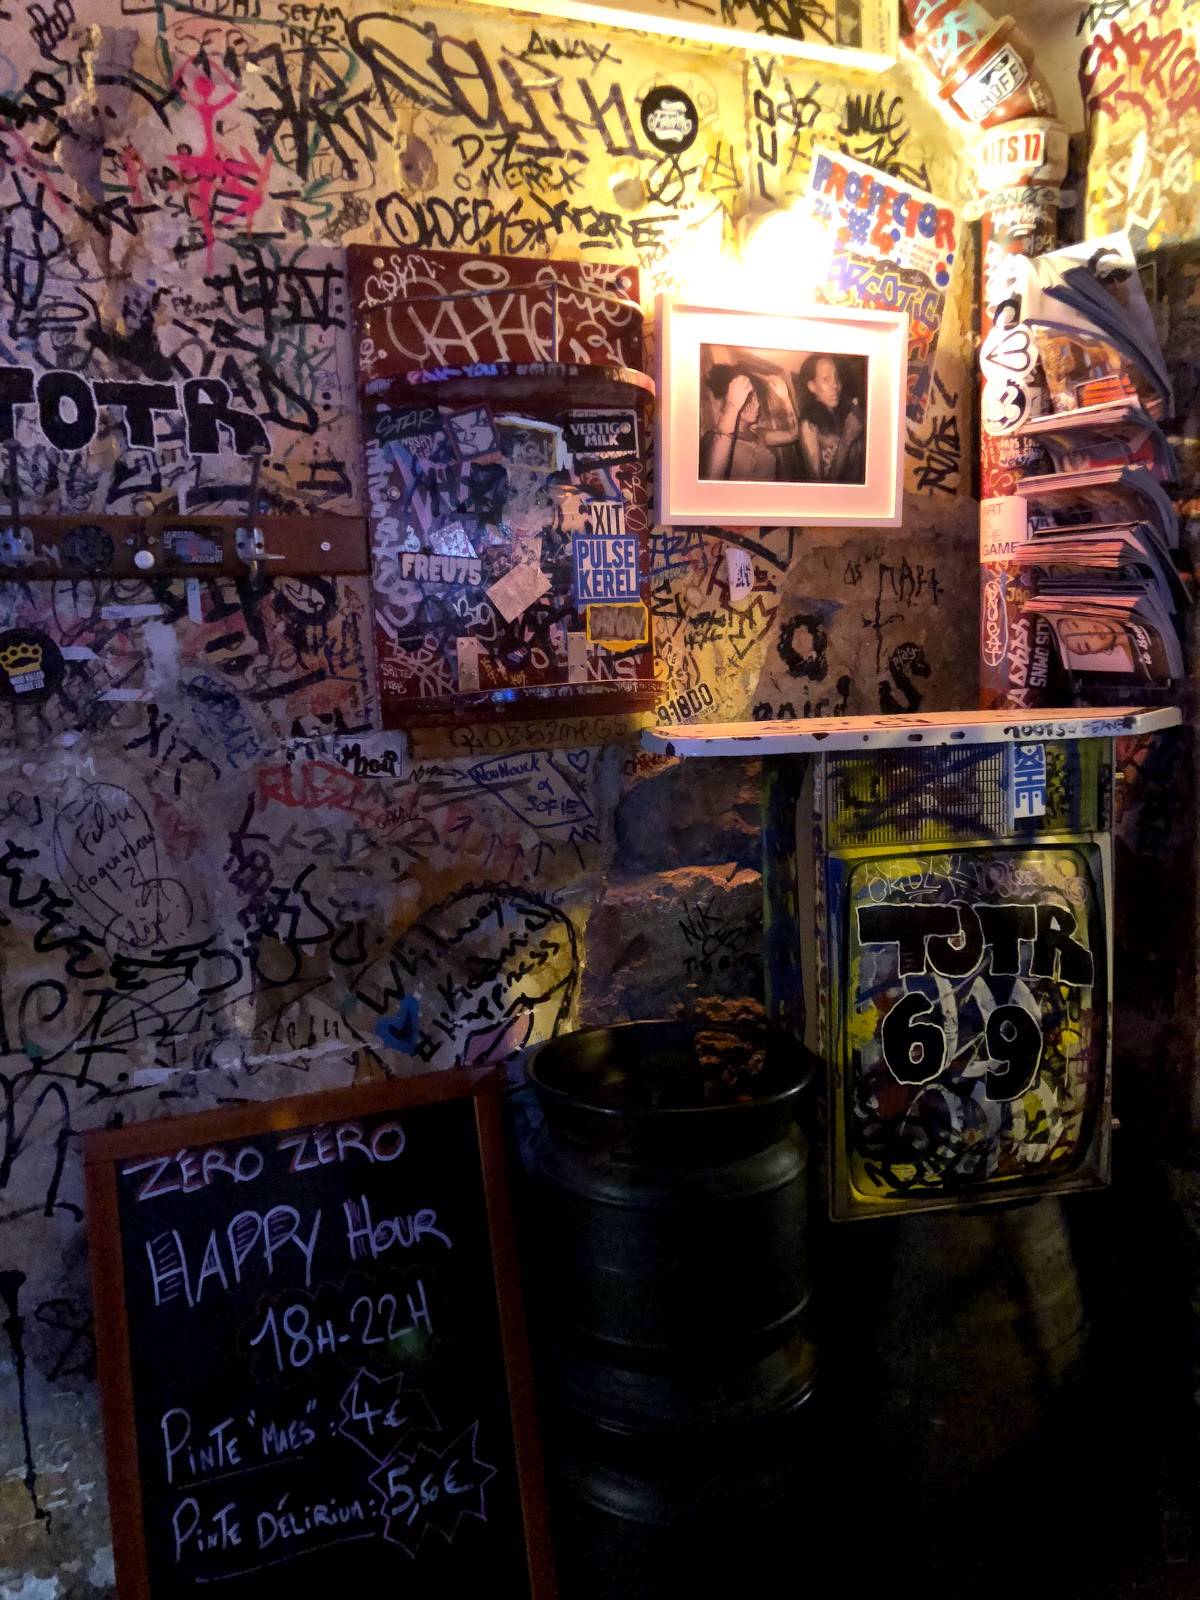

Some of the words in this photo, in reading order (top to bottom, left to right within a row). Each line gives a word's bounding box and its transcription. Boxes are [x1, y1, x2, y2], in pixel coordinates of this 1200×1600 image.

[1023, 134, 1041, 161] 17
[813, 154, 956, 251] PROSPECTOR
[569, 421, 631, 436] VERTIGO
[584, 434, 619, 447] MILK
[578, 540, 634, 568] PULSE
[983, 541, 1020, 556] GAME
[145, 1204, 322, 1308] HAPPY
